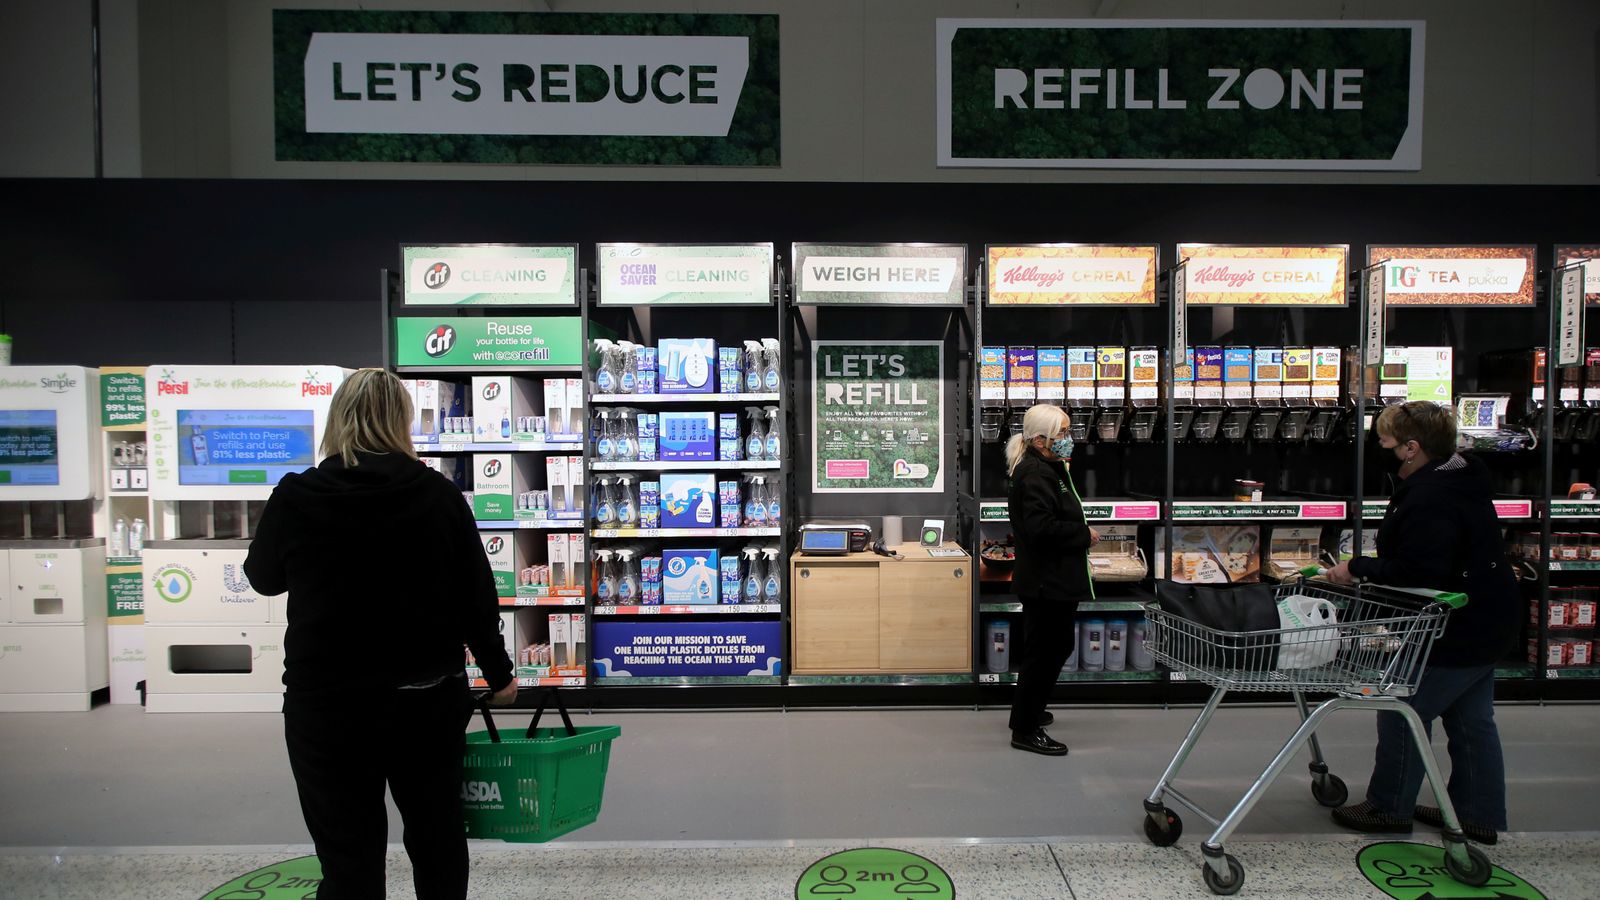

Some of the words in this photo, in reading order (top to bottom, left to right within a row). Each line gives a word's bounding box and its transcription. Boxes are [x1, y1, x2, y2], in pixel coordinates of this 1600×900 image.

[332, 62, 481, 103] LET'S
[503, 63, 719, 104] REDUCE
[994, 68, 1187, 109] REFILL
[1207, 68, 1364, 110] ZONE
[461, 269, 547, 282] CLEANING
[620, 264, 657, 275] OCEAN
[665, 269, 750, 283] CLEANING
[813, 266, 880, 282] WEIGH
[888, 267, 940, 283] HERE
[620, 275, 657, 286] SAVER
[1003, 265, 1065, 288] Kellogg's
[1072, 270, 1136, 283] CEREAL
[1194, 265, 1256, 288] Kellogg's
[1262, 270, 1325, 283] CEREAL
[1390, 265, 1416, 288] PG
[1428, 271, 1460, 283] TEA
[1468, 274, 1508, 287] pukka
[487, 322, 533, 335] Reuse
[476, 338, 494, 346] your
[496, 337, 519, 345] bottle
[520, 337, 531, 345] for
[533, 337, 545, 345] life
[473, 350, 494, 360] with
[495, 347, 551, 360] ecorefill
[825, 354, 906, 377] LET'S
[41, 377, 77, 390] Simple
[110, 376, 139, 384] Switch
[119, 385, 142, 393] refills
[157, 381, 189, 396] Persil
[301, 382, 332, 397] Persil
[825, 383, 928, 405] REFILL
[213, 431, 247, 440] Switch
[249, 432, 260, 440] to
[263, 431, 290, 440] Persil
[217, 441, 244, 450] refills
[246, 441, 265, 450] and
[267, 442, 286, 450] use
[212, 450, 232, 459] 81%
[235, 450, 255, 459] less
[257, 450, 292, 460] plastic
[116, 602, 145, 610] FREE
[632, 636, 652, 645] JOIN
[654, 636, 673, 645] OUR
[674, 636, 710, 644] MISSION
[712, 636, 724, 644] TO
[726, 636, 747, 644] SAVE
[614, 646, 631, 655] ONE
[633, 646, 667, 654] MILLION
[670, 646, 703, 654] PLASTIC
[704, 646, 739, 654] BOTTLES
[741, 645, 765, 654] FROM
[623, 656, 665, 664] REACHING
[667, 656, 683, 664] THE
[684, 656, 712, 664] OCEAN
[714, 655, 733, 664] THIS
[734, 655, 756, 663] YEAR
[856, 870, 895, 882] 2m
[1410, 864, 1450, 876] 2m
[277, 876, 319, 889] 2m
